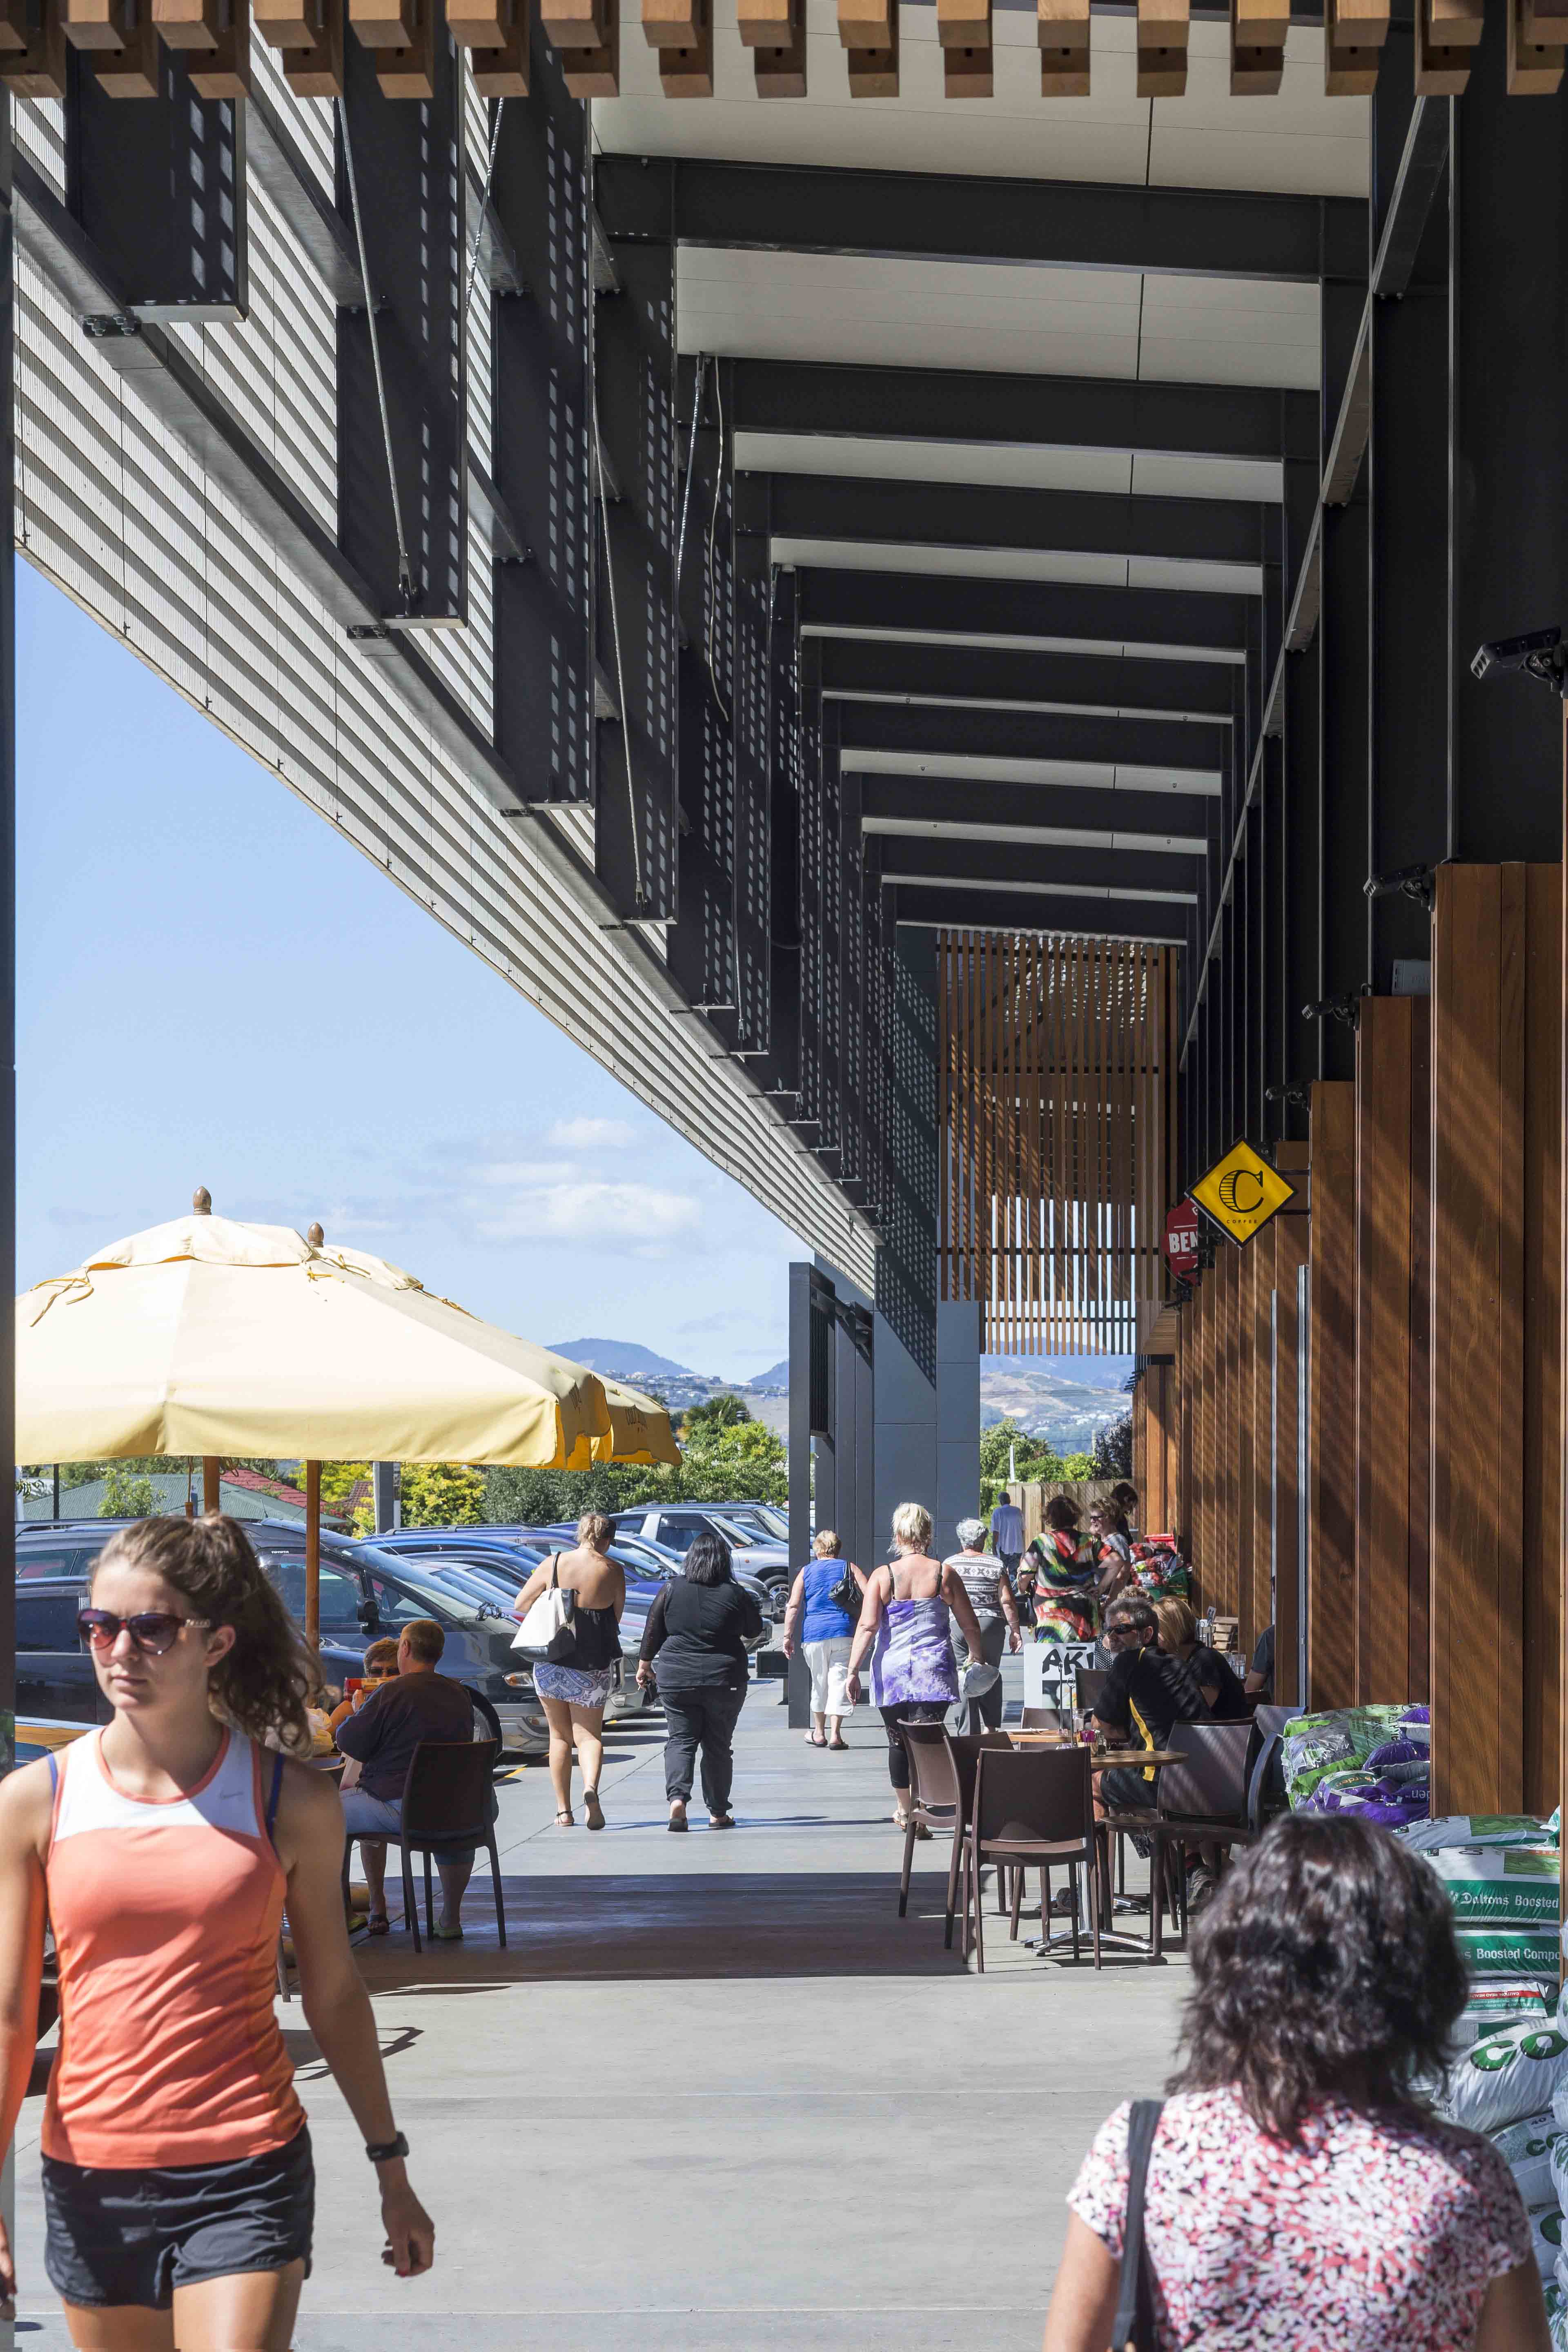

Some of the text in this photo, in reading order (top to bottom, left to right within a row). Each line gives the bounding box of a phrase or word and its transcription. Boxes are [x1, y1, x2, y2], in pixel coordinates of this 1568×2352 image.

[1219, 1169, 1264, 1213] C
[1461, 1892, 1559, 1908] Daltons Boosted
[1476, 1948, 1520, 1959] Boosted
